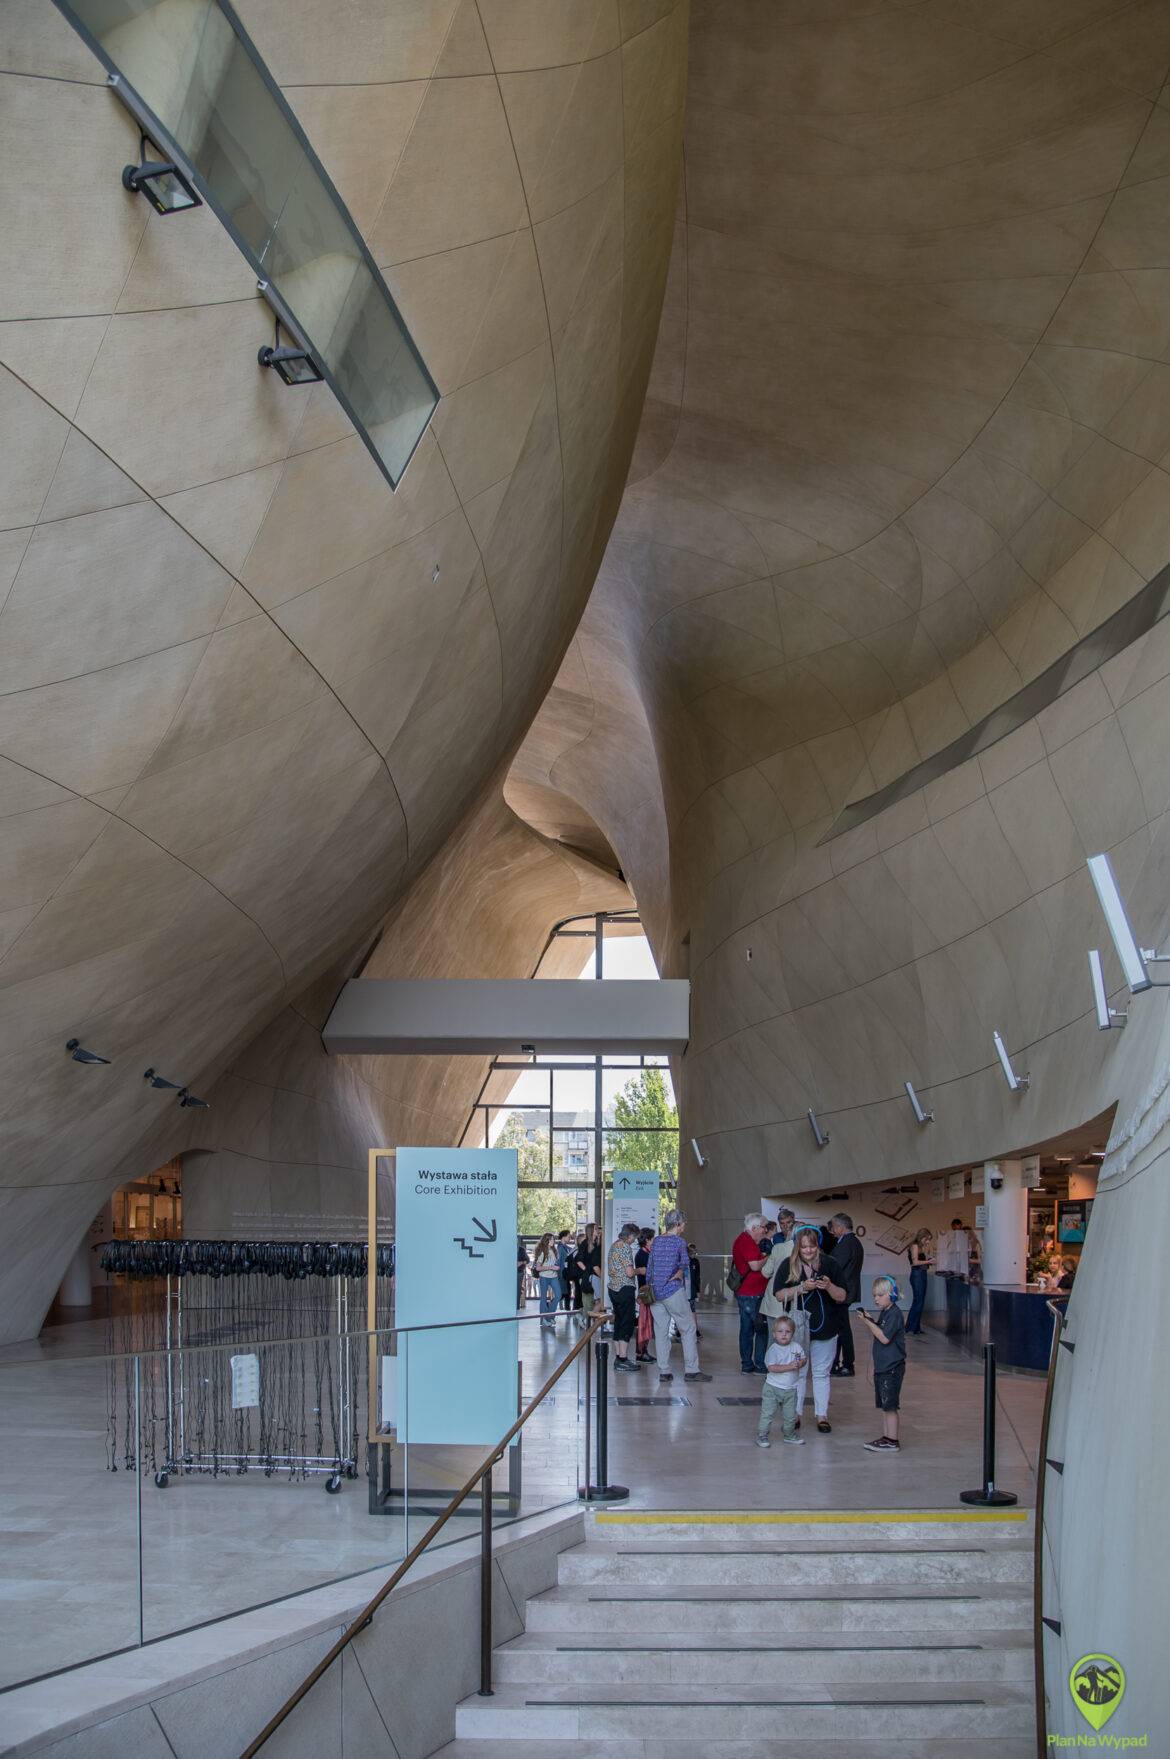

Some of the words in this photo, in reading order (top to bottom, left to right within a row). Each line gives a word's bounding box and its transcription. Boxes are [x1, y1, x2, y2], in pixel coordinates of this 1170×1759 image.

[418, 1170, 468, 1181] Wystawa
[470, 1170, 498, 1181] stała
[414, 1184, 441, 1195] Core
[443, 1184, 498, 1195] Exhibition
